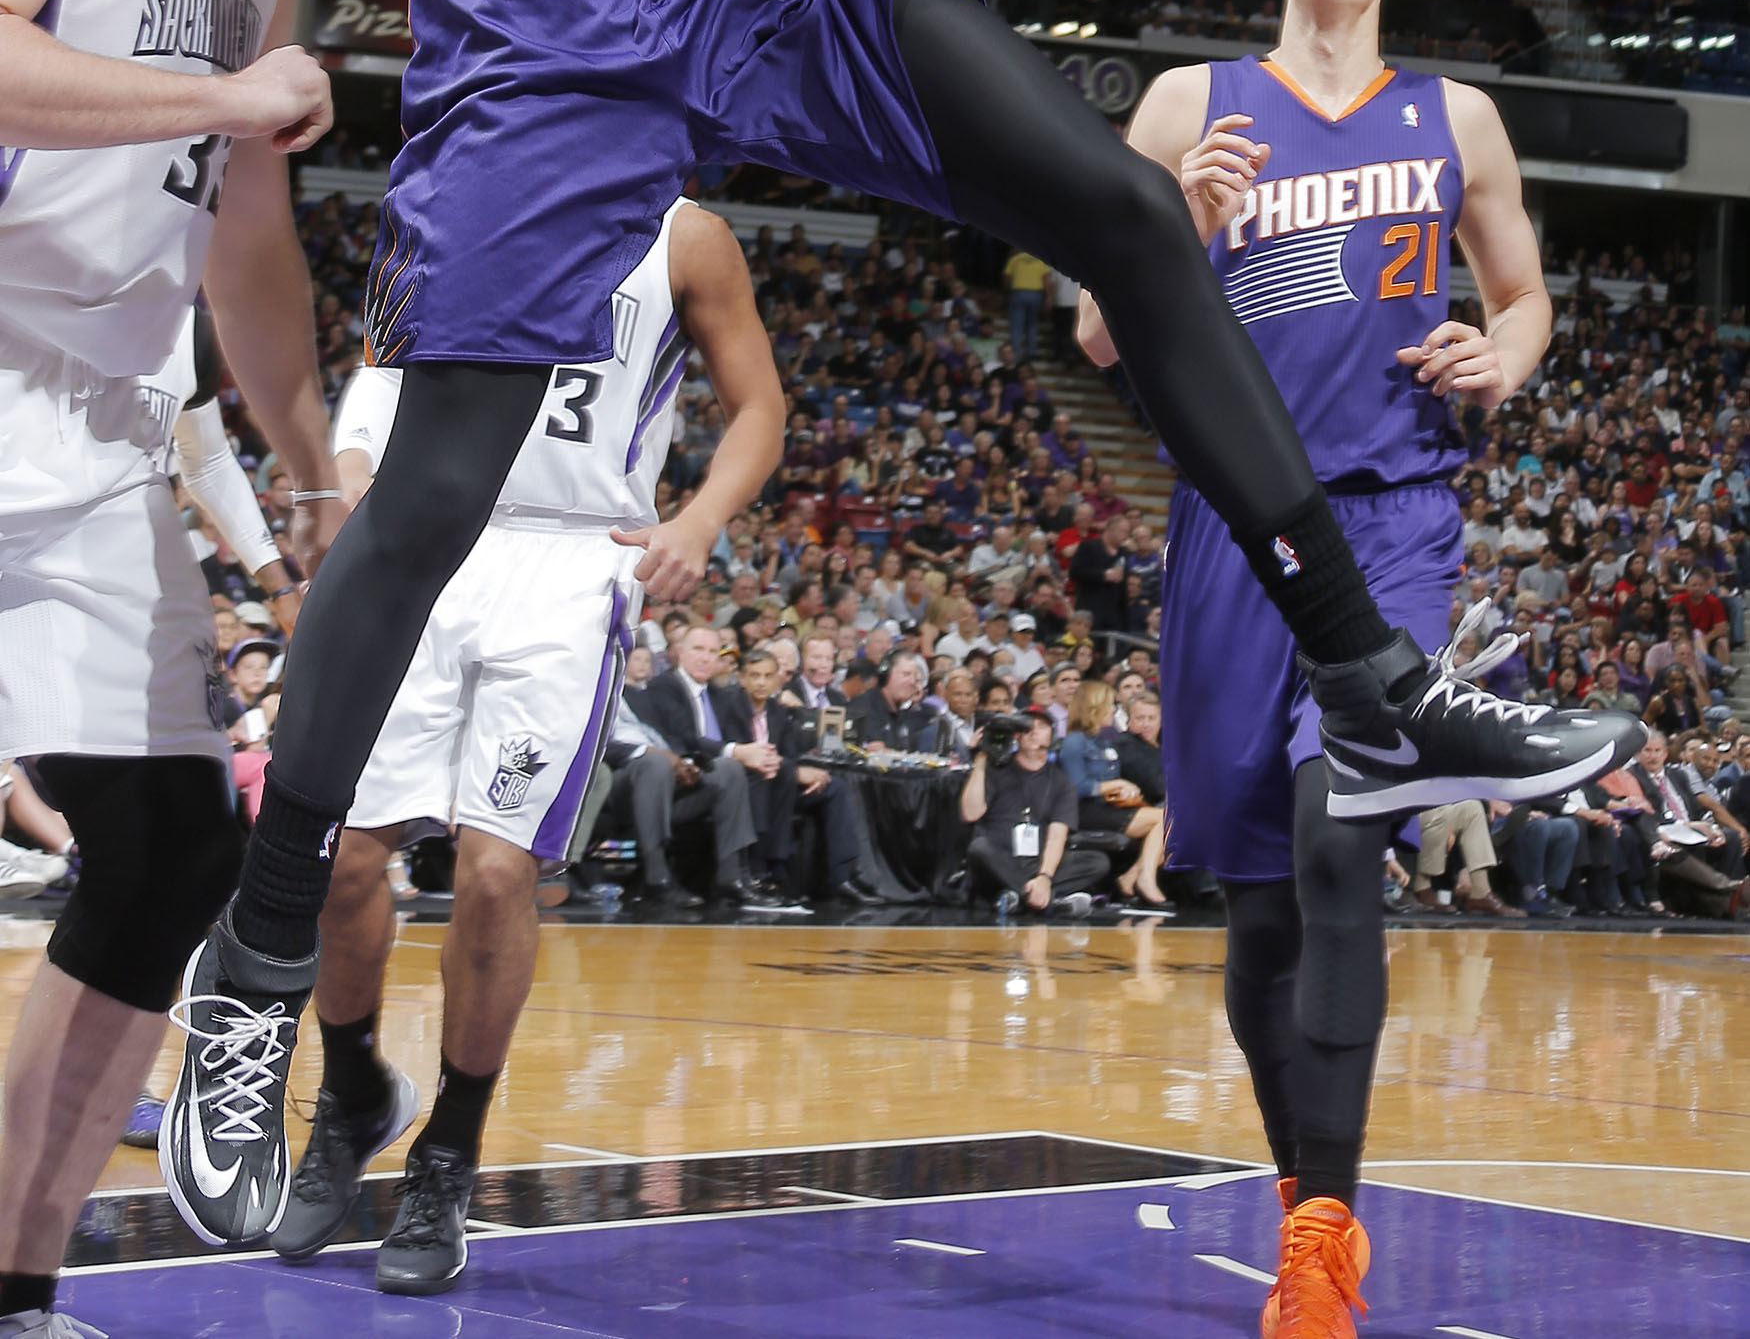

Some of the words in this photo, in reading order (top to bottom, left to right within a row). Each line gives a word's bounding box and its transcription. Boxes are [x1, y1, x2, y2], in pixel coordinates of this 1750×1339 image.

[1228, 157, 1448, 252] PHOENIX
[1378, 220, 1440, 301] 21
[546, 367, 605, 445] 3
